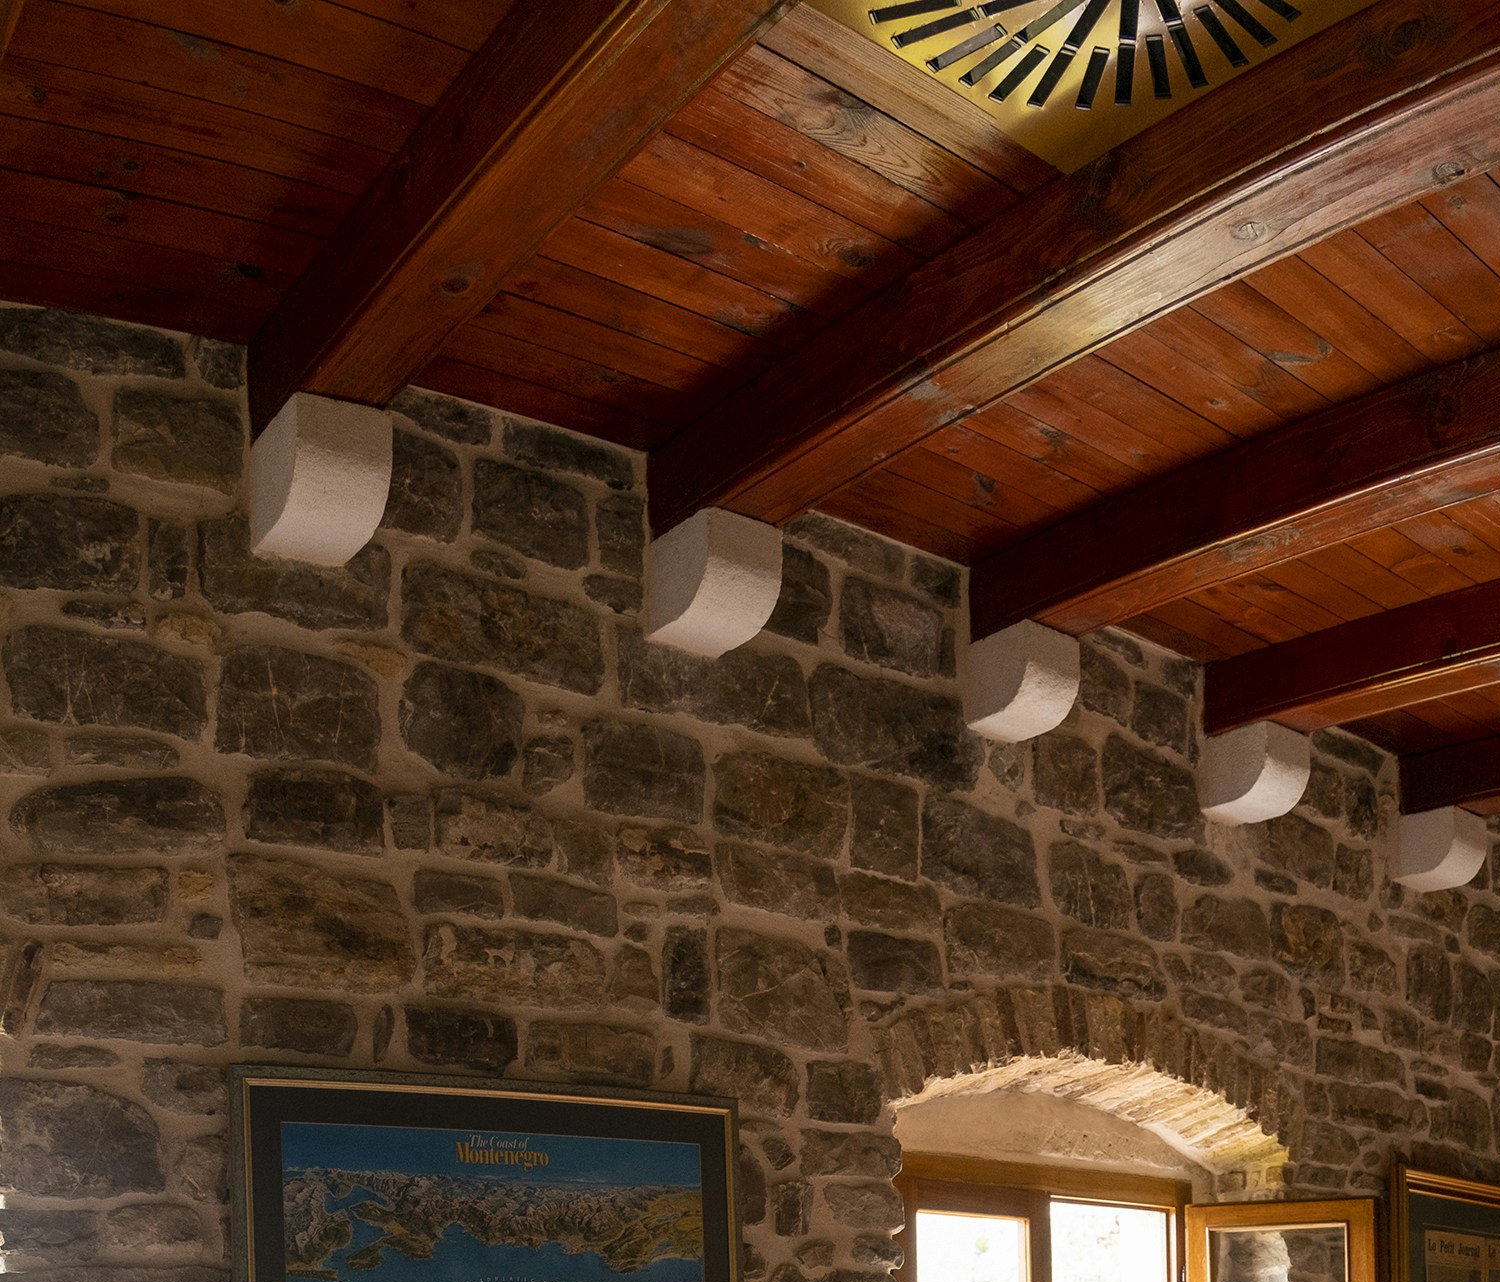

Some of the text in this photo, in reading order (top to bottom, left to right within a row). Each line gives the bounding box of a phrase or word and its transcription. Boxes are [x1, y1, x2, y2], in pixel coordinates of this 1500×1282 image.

[470, 1135, 529, 1151] The Coast of
[456, 1141, 550, 1172] Montenegro
[1427, 1239, 1481, 1258] Le Petit Journal
[1488, 1246, 1495, 1257] Le
